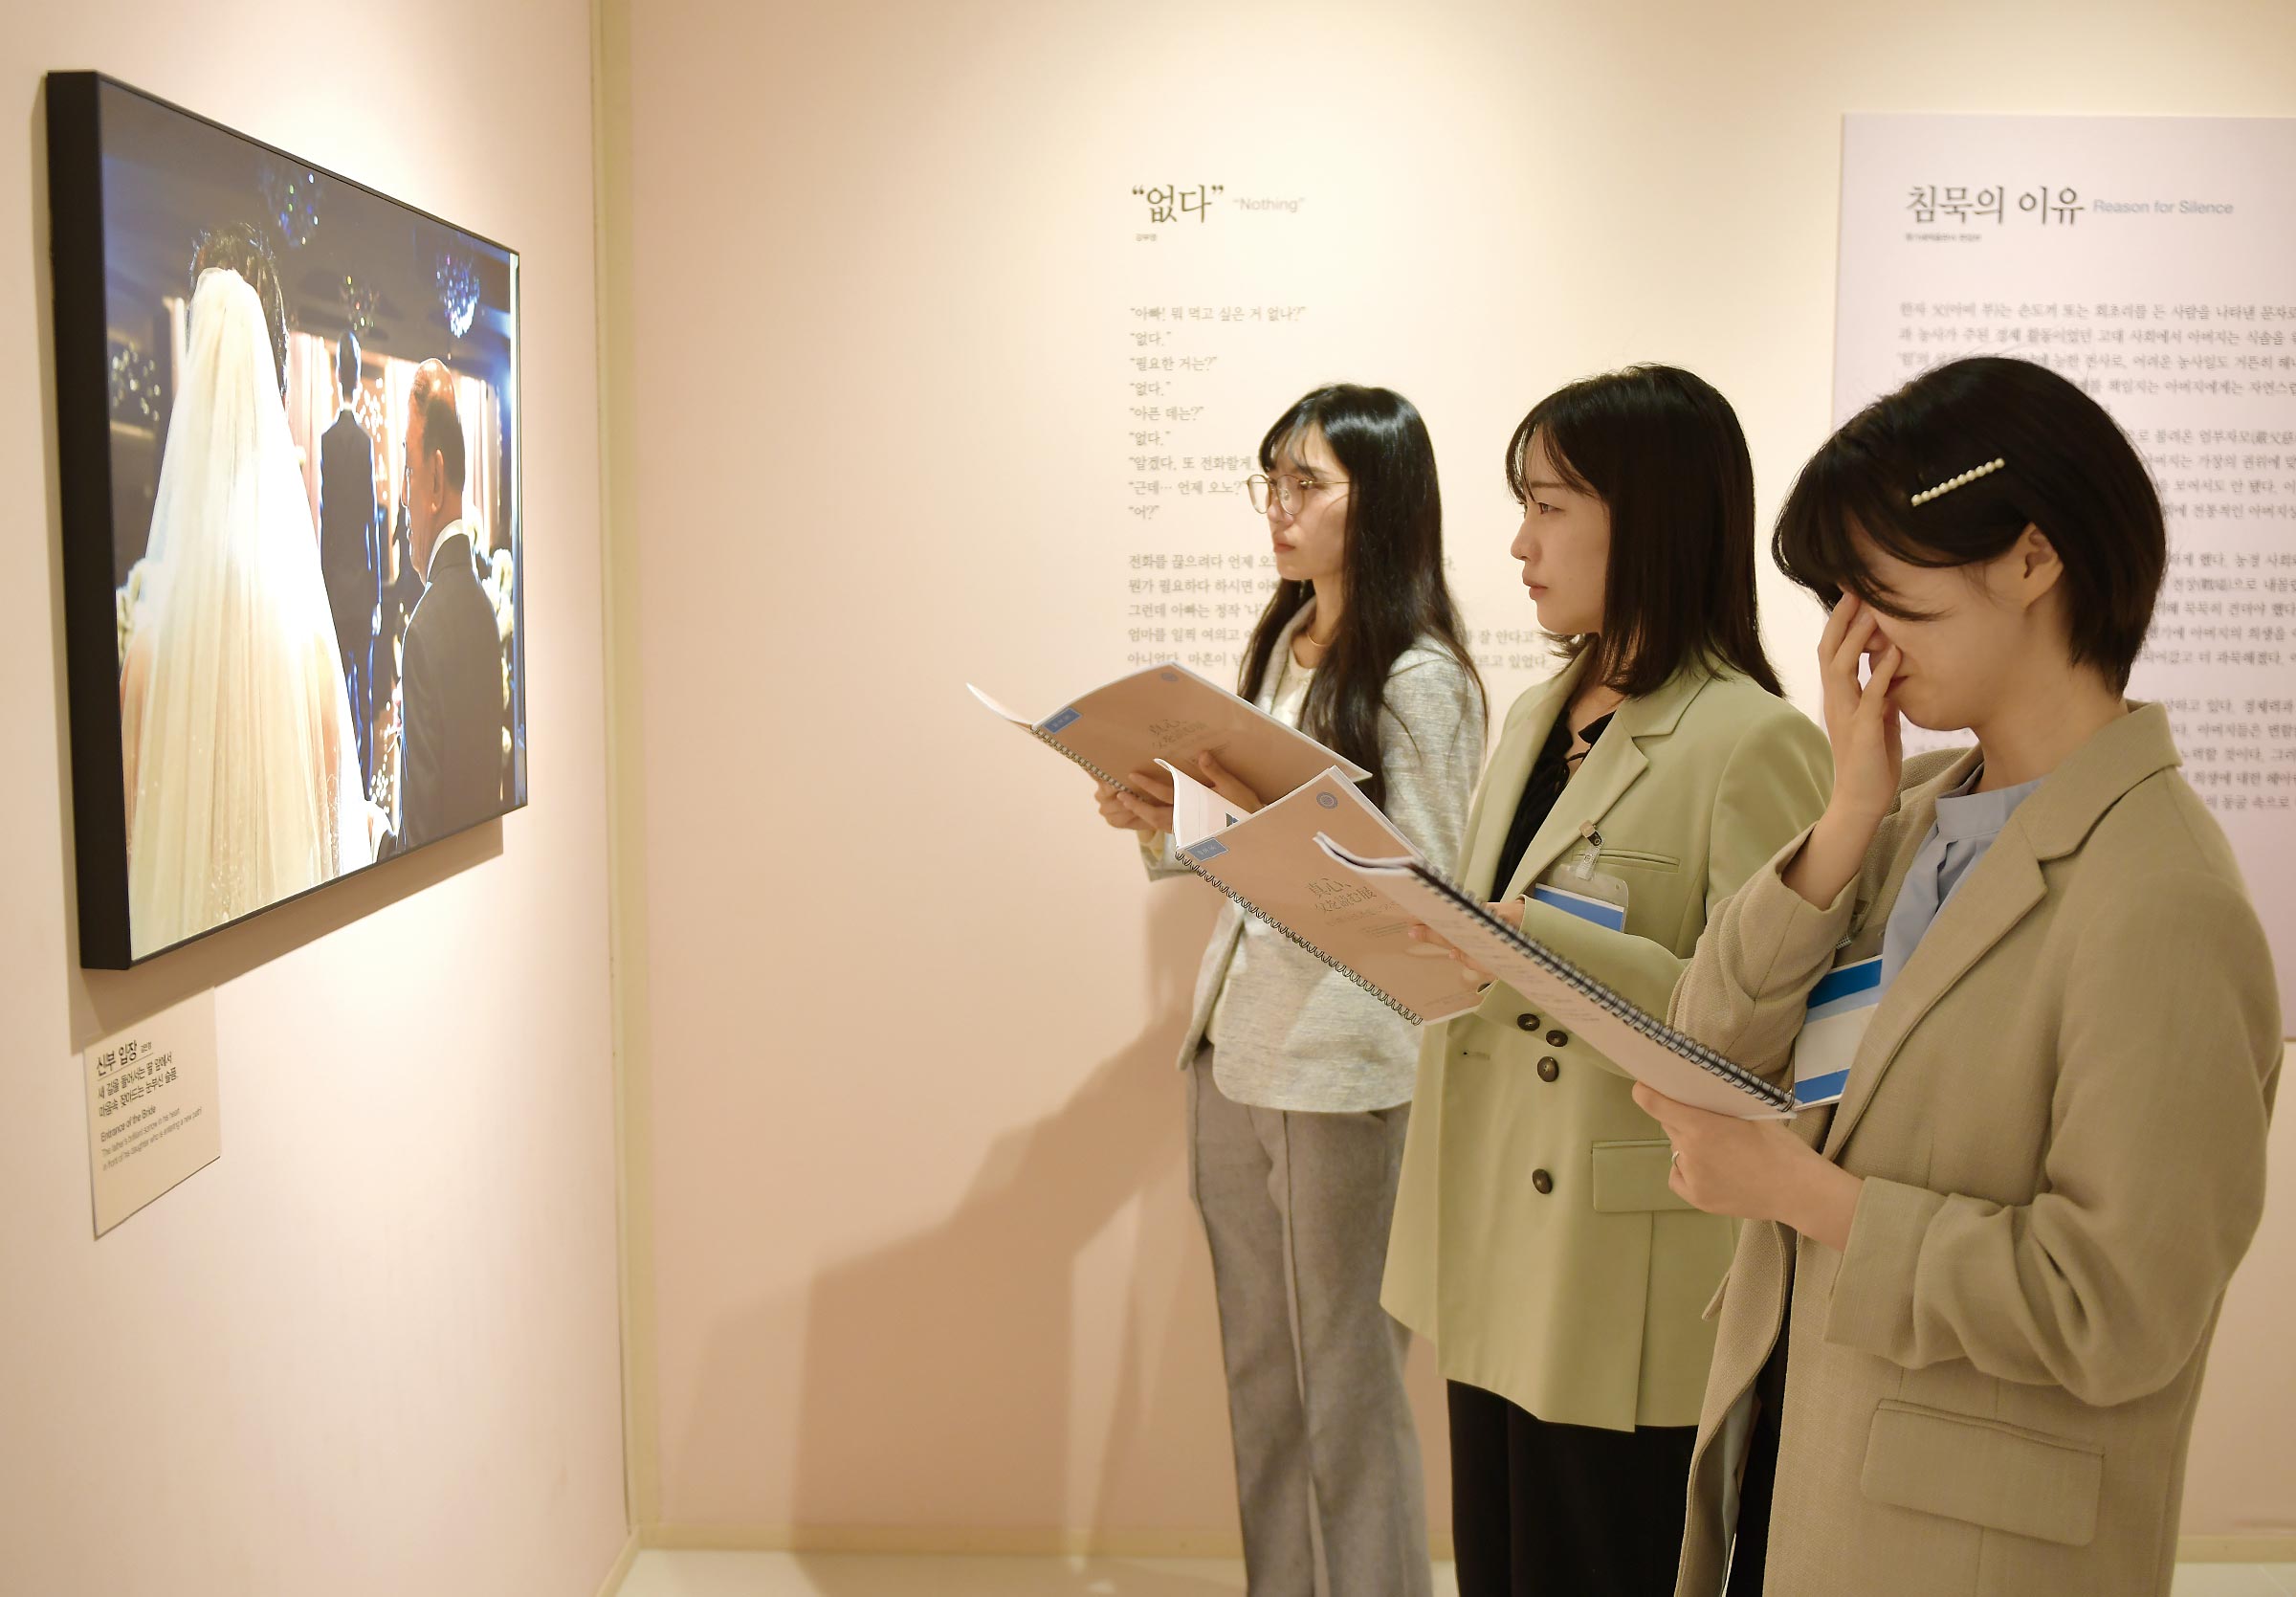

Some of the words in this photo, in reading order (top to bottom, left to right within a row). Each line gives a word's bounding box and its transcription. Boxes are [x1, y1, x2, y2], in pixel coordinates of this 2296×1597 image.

[1132, 184, 1224, 223] “없다”
[1906, 185, 2005, 225] 침묵의
[2018, 185, 2084, 225] 이유
[2093, 199, 2148, 213] Reason
[2154, 199, 2175, 213] for
[2179, 200, 2234, 214] Silence
[1189, 306, 1214, 321] 먹고
[1219, 306, 1245, 322] 싶은
[1249, 306, 1262, 321] 거
[2172, 304, 2210, 320] 사람을
[2130, 329, 2181, 344] 사회에서
[2188, 329, 2240, 345] 아버지는
[2165, 379, 2243, 395] 아버지에게는
[1182, 456, 1195, 469] 또
[1178, 480, 1203, 495] 언제
[1128, 554, 1167, 569] 전화를
[1172, 554, 1223, 569] 끊으려다
[1228, 554, 1254, 569] 언제
[1128, 578, 1154, 593] 뭔가
[1159, 578, 1209, 593] 필요하다
[1215, 579, 1253, 594] 하시면
[1128, 603, 1166, 618] 그런데
[1171, 603, 1209, 618] 아빠는
[1215, 604, 1241, 618] 정작
[1128, 627, 1166, 642] 엄마를
[1171, 628, 1196, 642] 일찍
[1202, 628, 1240, 642] 여의고
[2190, 626, 2241, 641] 아버지의
[1188, 652, 1226, 666] 마흔이
[97, 1050, 116, 1076] 신부
[119, 1039, 137, 1066] 입장
[98, 1086, 105, 1099] 새
[107, 1078, 120, 1097] 길을
[121, 1067, 145, 1089] 들어서는
[154, 1051, 172, 1072] 앞에서
[99, 1098, 119, 1118] 마음속
[145, 1074, 164, 1095] 눈부신
[100, 1122, 125, 1142] Entrance
[126, 1116, 132, 1128] of
[133, 1114, 142, 1125] the
[142, 1105, 156, 1120] Bride
